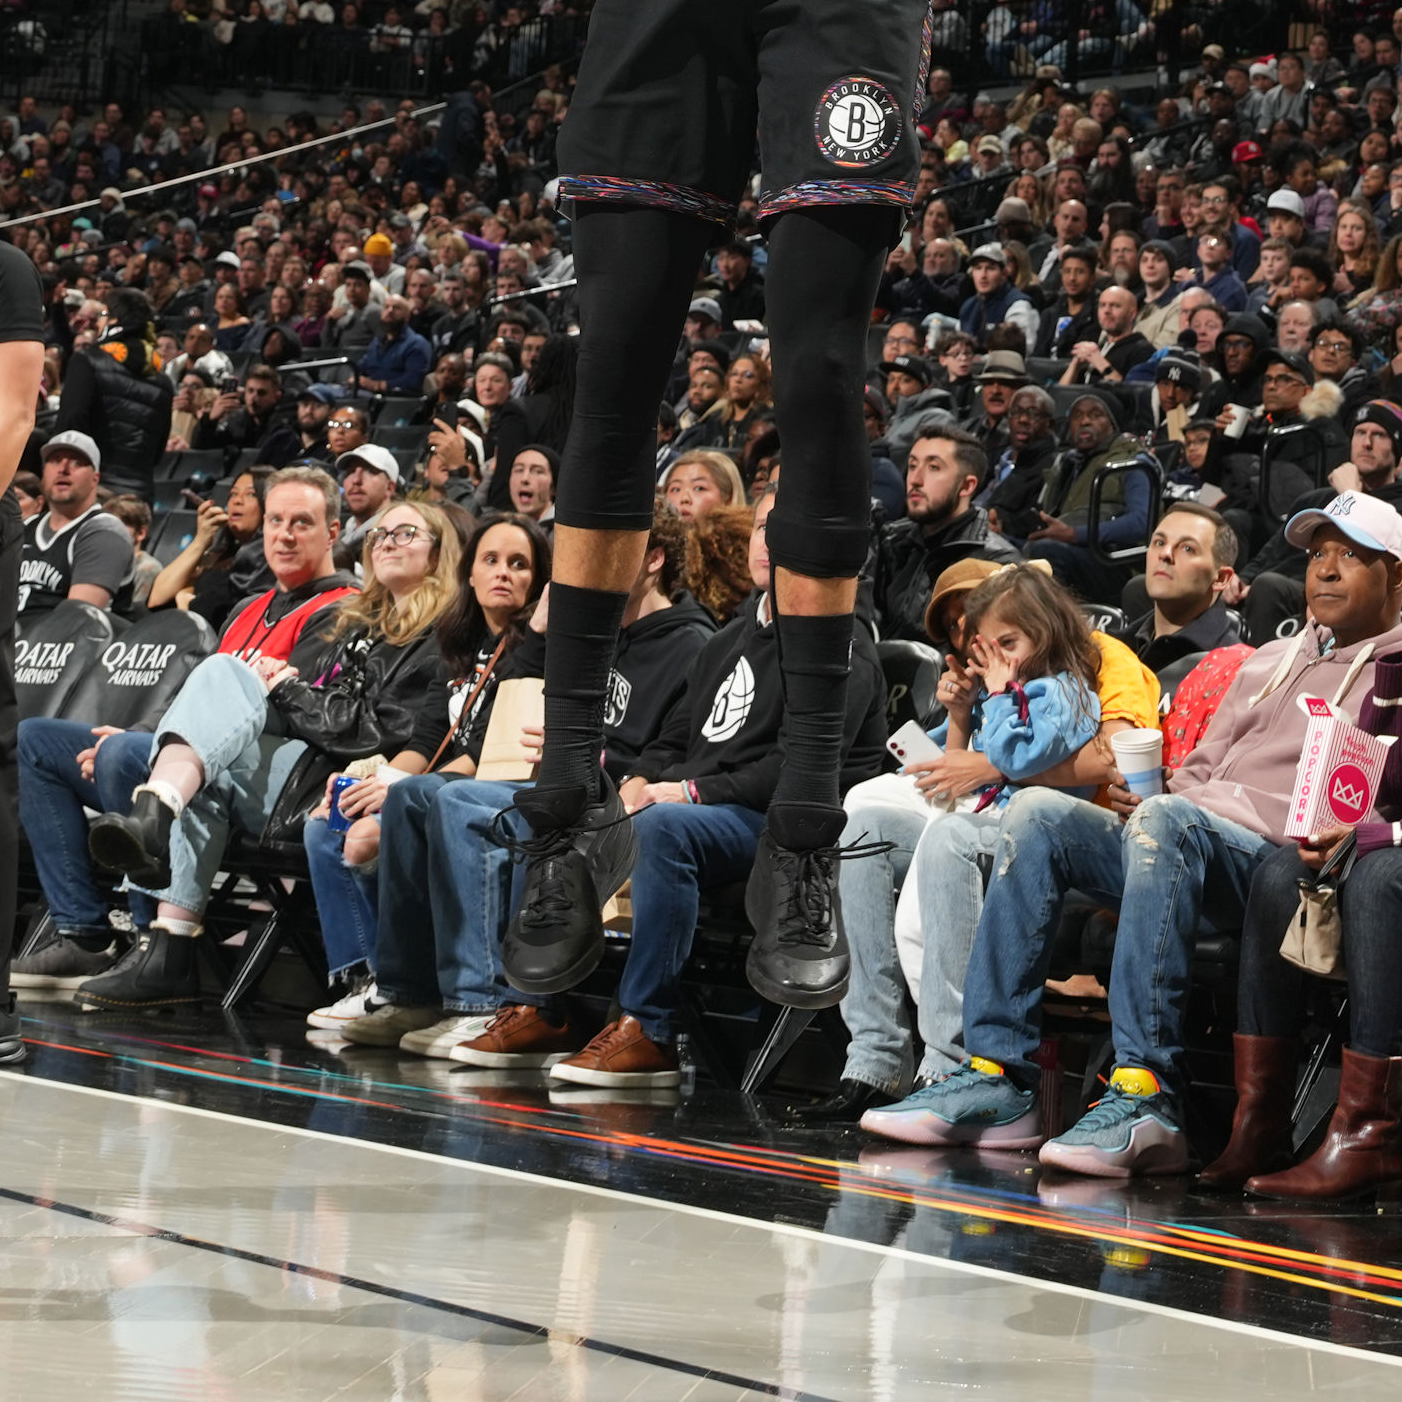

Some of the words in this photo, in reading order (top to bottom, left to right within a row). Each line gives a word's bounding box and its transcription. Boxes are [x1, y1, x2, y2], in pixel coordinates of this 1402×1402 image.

[825, 83, 894, 116] BROOKLYN
[823, 136, 847, 159] NEW
[853, 141, 888, 160] YORK
[18, 560, 63, 592] OOKLYN
[102, 641, 176, 672] QATAR
[106, 669, 163, 686] AIRWAYS
[1296, 730, 1324, 823] POPCORN
